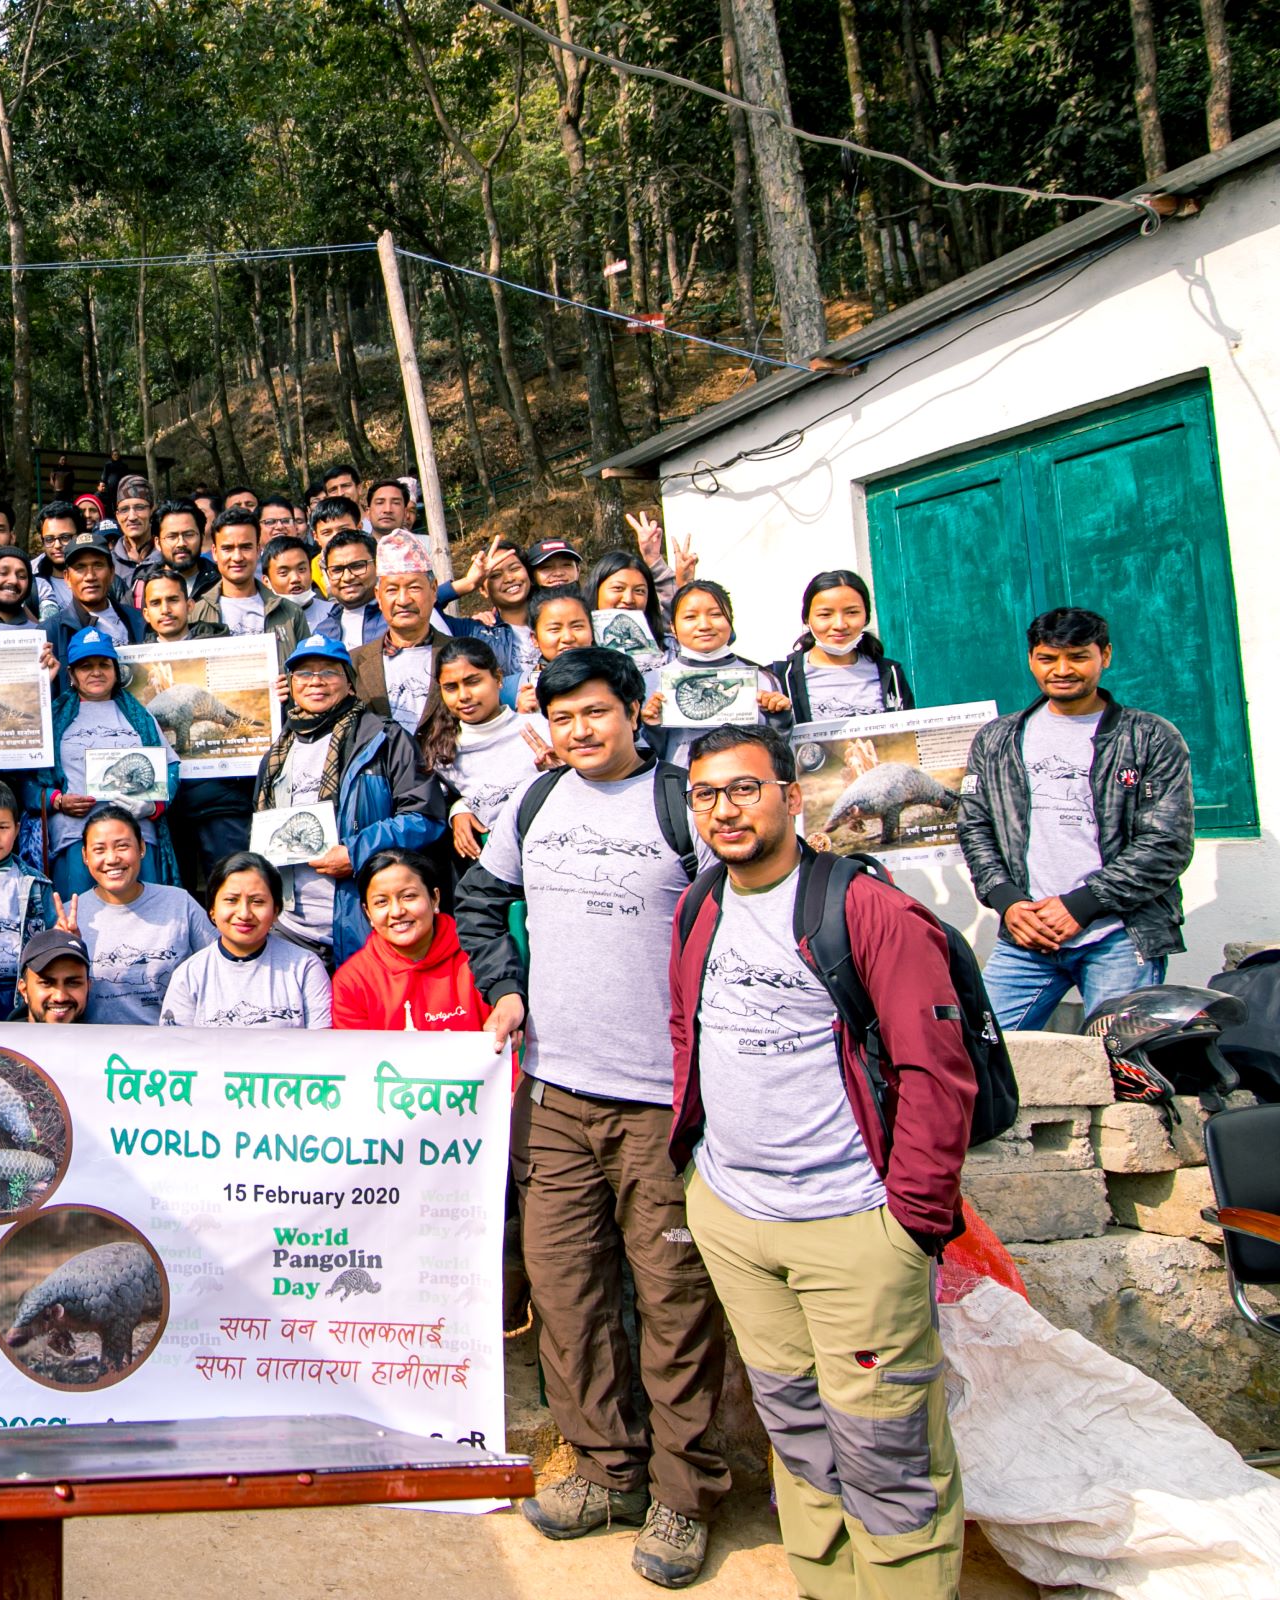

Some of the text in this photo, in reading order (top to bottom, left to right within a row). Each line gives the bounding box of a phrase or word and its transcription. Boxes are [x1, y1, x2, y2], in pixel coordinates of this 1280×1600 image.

[104, 1053, 485, 1120] विश्व सालक दिवस
[110, 1126, 483, 1166] WORLD PANGOLIN DAY
[223, 1183, 400, 1210] 15 February 2020
[272, 1227, 349, 1247] World
[166, 1261, 224, 1276] angolin
[272, 1248, 383, 1273] Pangolin
[272, 1277, 321, 1300] Day
[162, 1333, 222, 1347] angolin
[219, 1316, 446, 1351] सफा वन सालकलाई
[195, 1354, 472, 1391] सफा वातावरण हामीलाई
